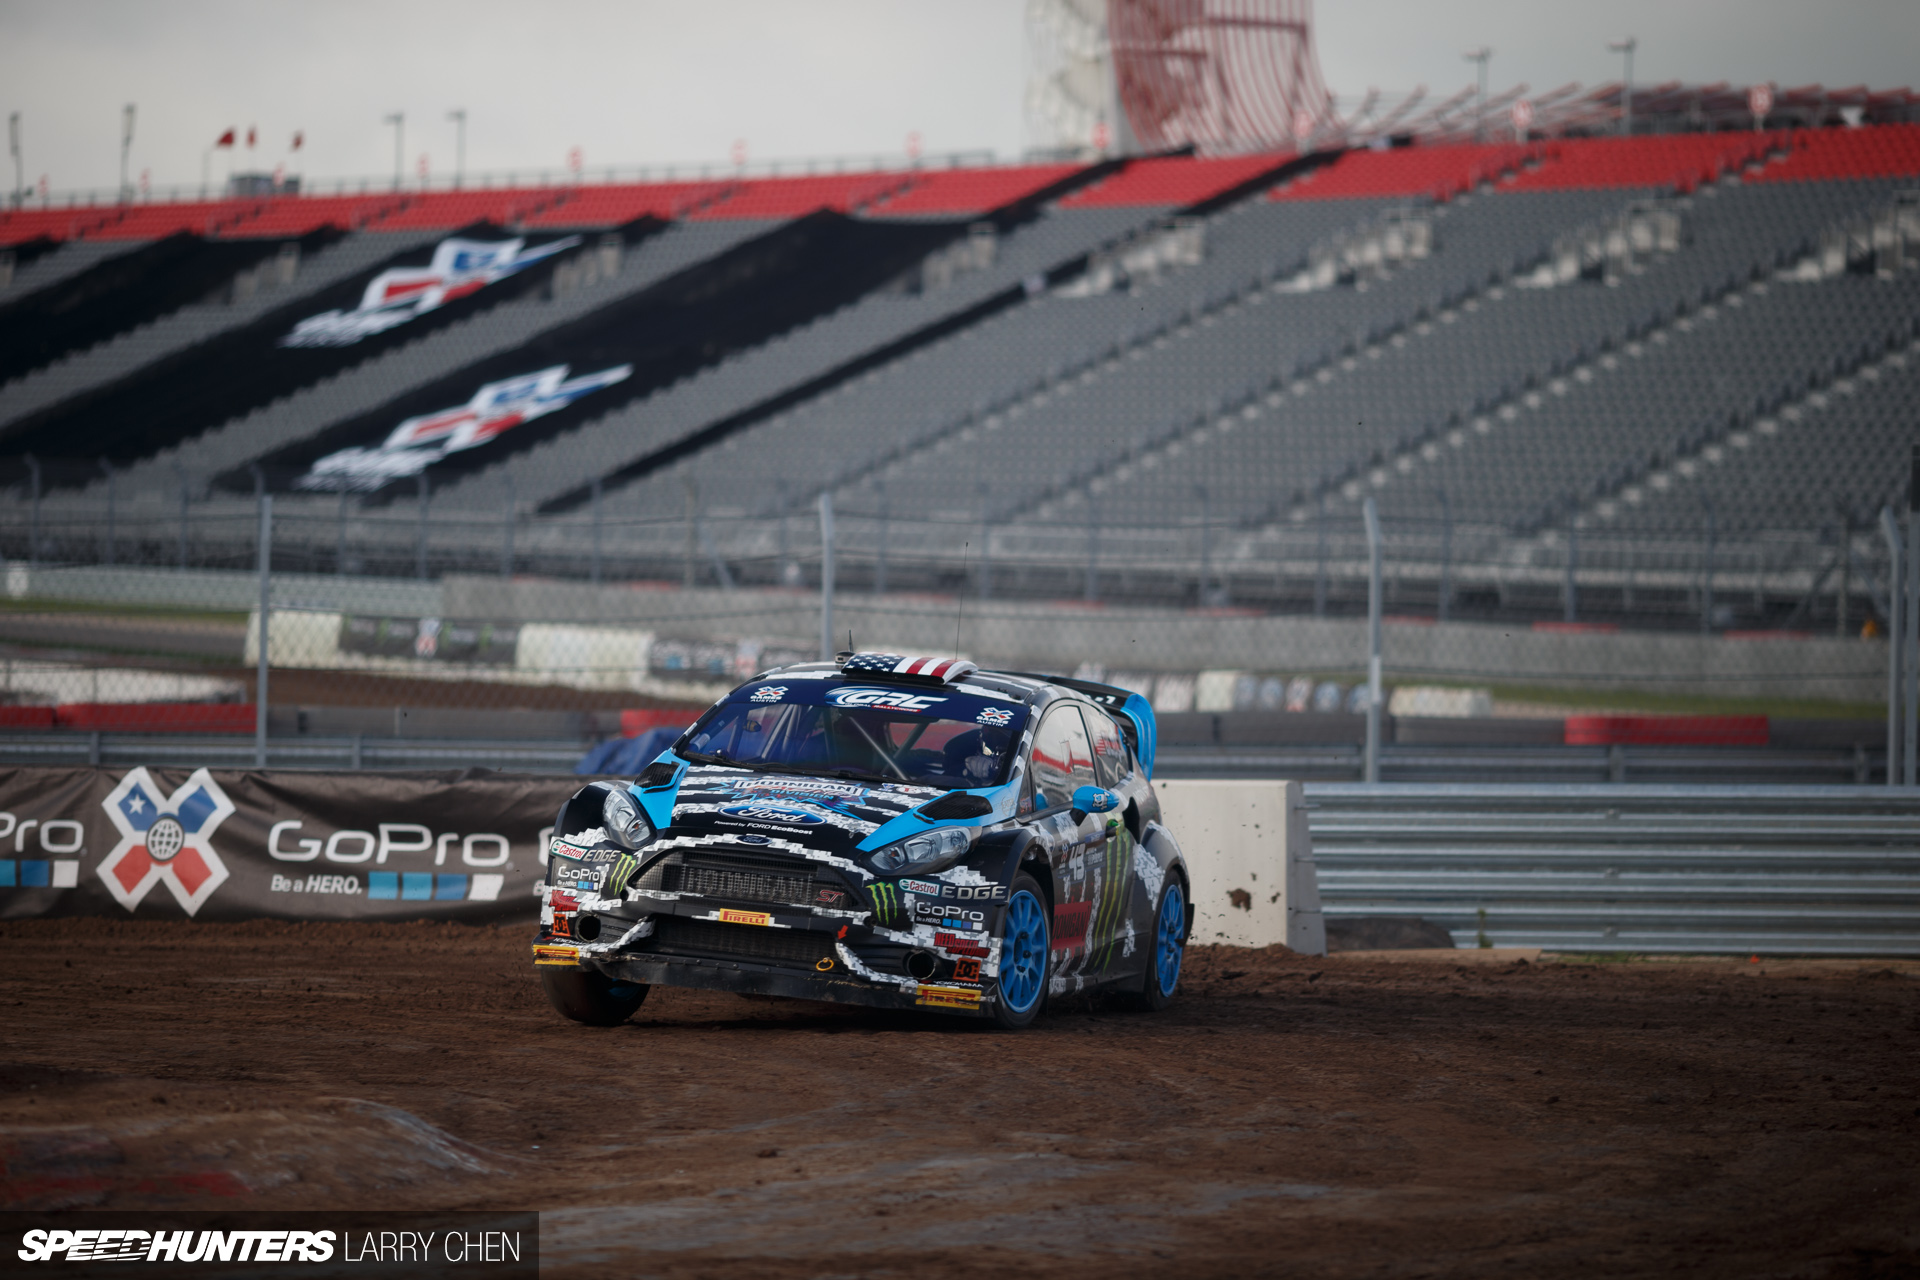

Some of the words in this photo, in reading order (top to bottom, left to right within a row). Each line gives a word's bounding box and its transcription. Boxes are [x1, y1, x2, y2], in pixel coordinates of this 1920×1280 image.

[843, 689, 949, 709] GRC
[737, 806, 807, 822] Ford
[770, 825, 814, 835] EcoBoost
[268, 820, 510, 868] GoPro
[559, 844, 585, 859] Castrol
[583, 849, 622, 863] EDGE
[558, 865, 600, 881] GoPro
[271, 873, 292, 892] Be
[293, 878, 304, 893] a
[909, 880, 939, 895] Castrol
[816, 889, 845, 902] ST
[941, 885, 1007, 900] EDGE
[723, 910, 767, 925] PIRELLI
[916, 901, 985, 921] GoPro
